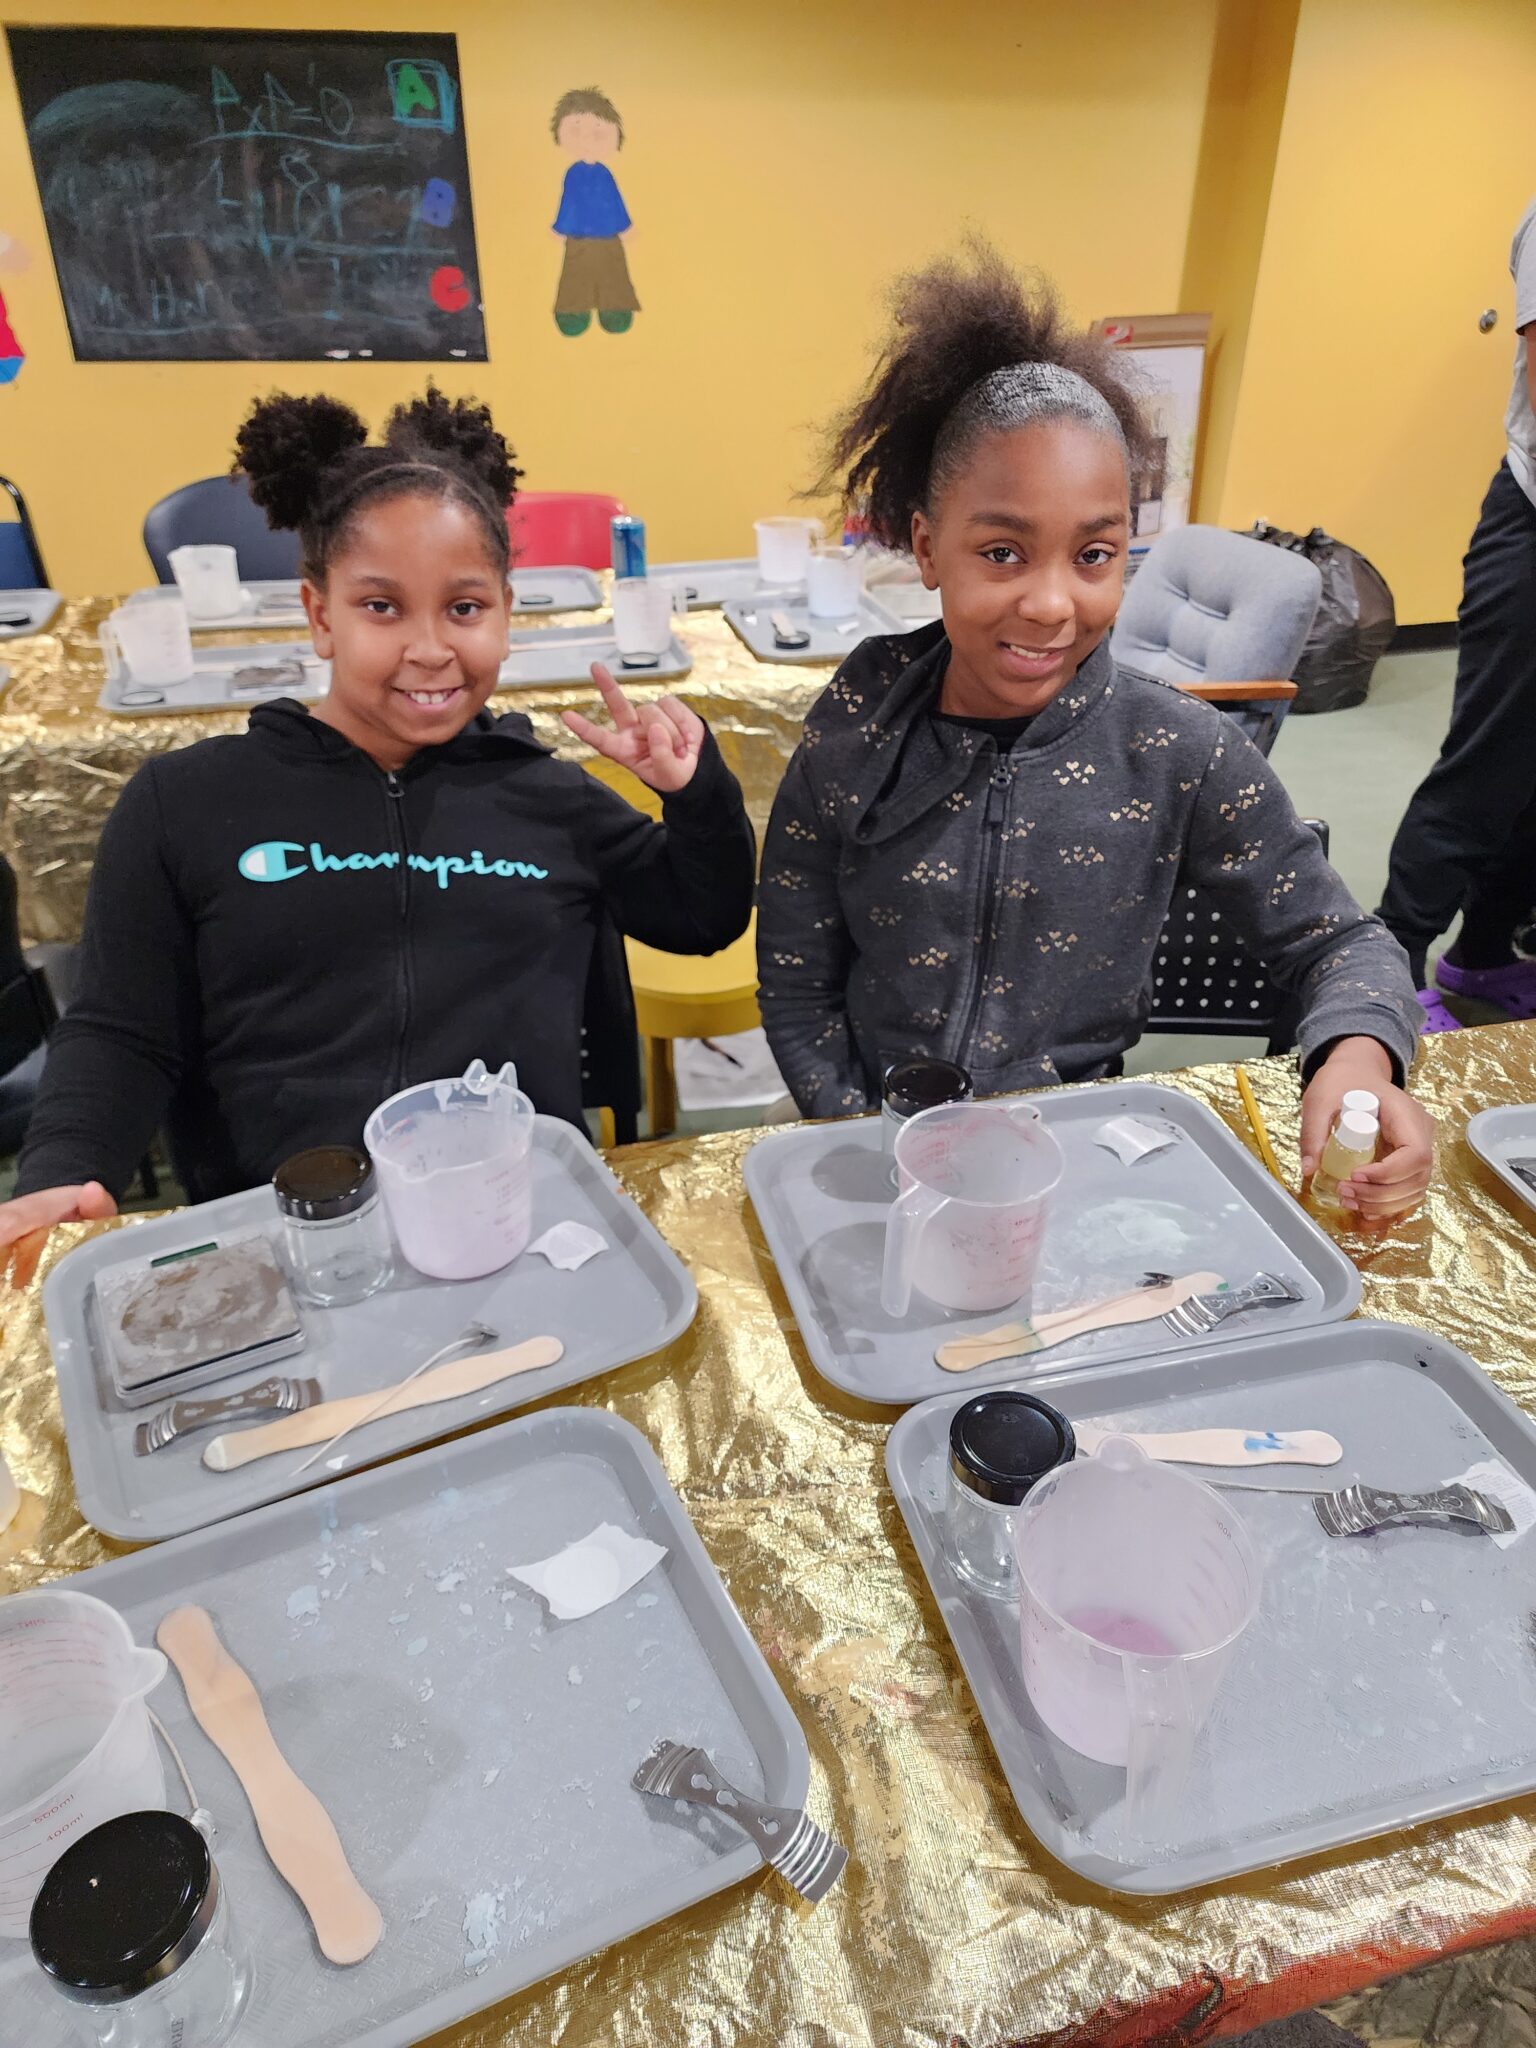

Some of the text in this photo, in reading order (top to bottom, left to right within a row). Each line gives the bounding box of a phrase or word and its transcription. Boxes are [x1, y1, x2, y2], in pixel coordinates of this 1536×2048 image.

[396, 63, 437, 117] A
[237, 840, 549, 889] Champion
[32, 1793, 75, 1825] 500ml
[46, 1812, 85, 1843] 400ml
